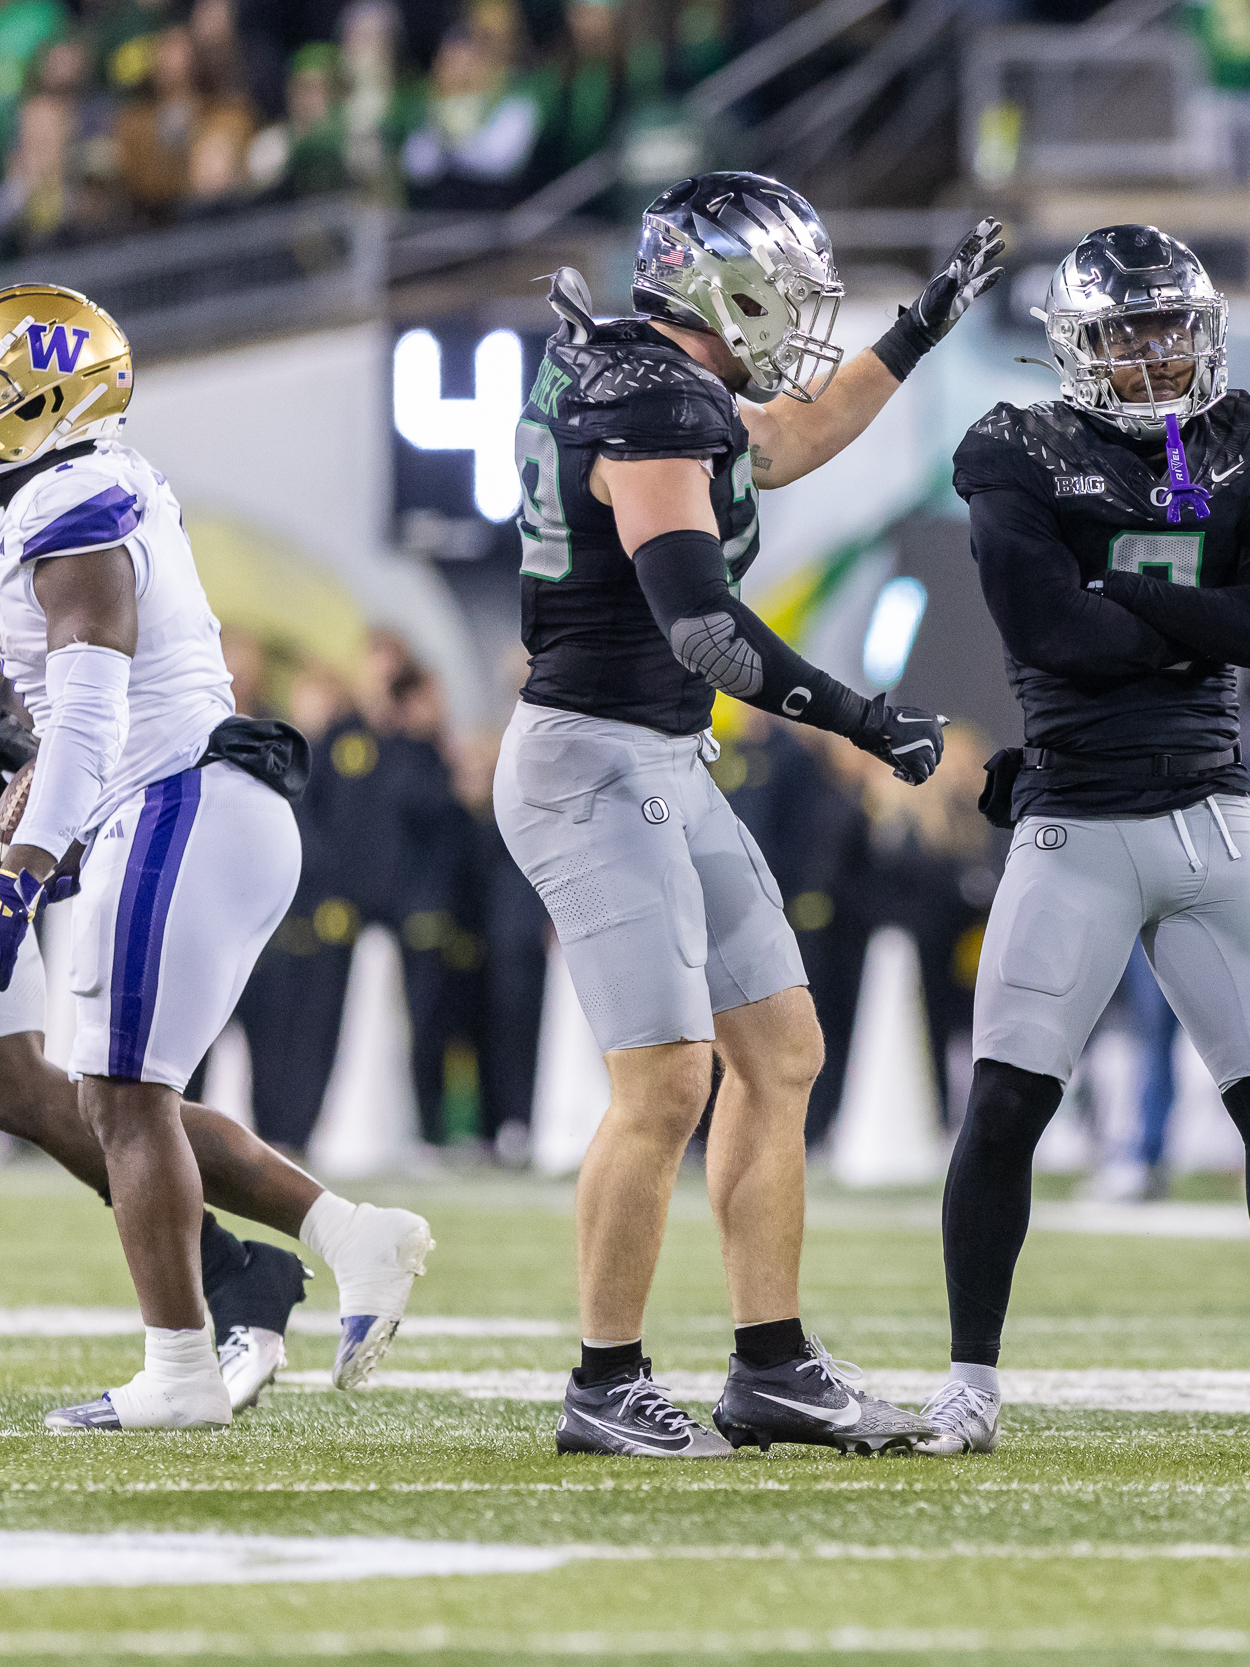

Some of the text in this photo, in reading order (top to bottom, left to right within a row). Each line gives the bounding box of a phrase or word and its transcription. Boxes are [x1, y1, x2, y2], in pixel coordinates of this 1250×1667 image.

[25, 322, 91, 376] W
[393, 327, 523, 525] 4
[1171, 448, 1185, 482] RIVEL
[1150, 486, 1174, 507] O
[641, 796, 670, 825] O
[1034, 824, 1068, 851] O
